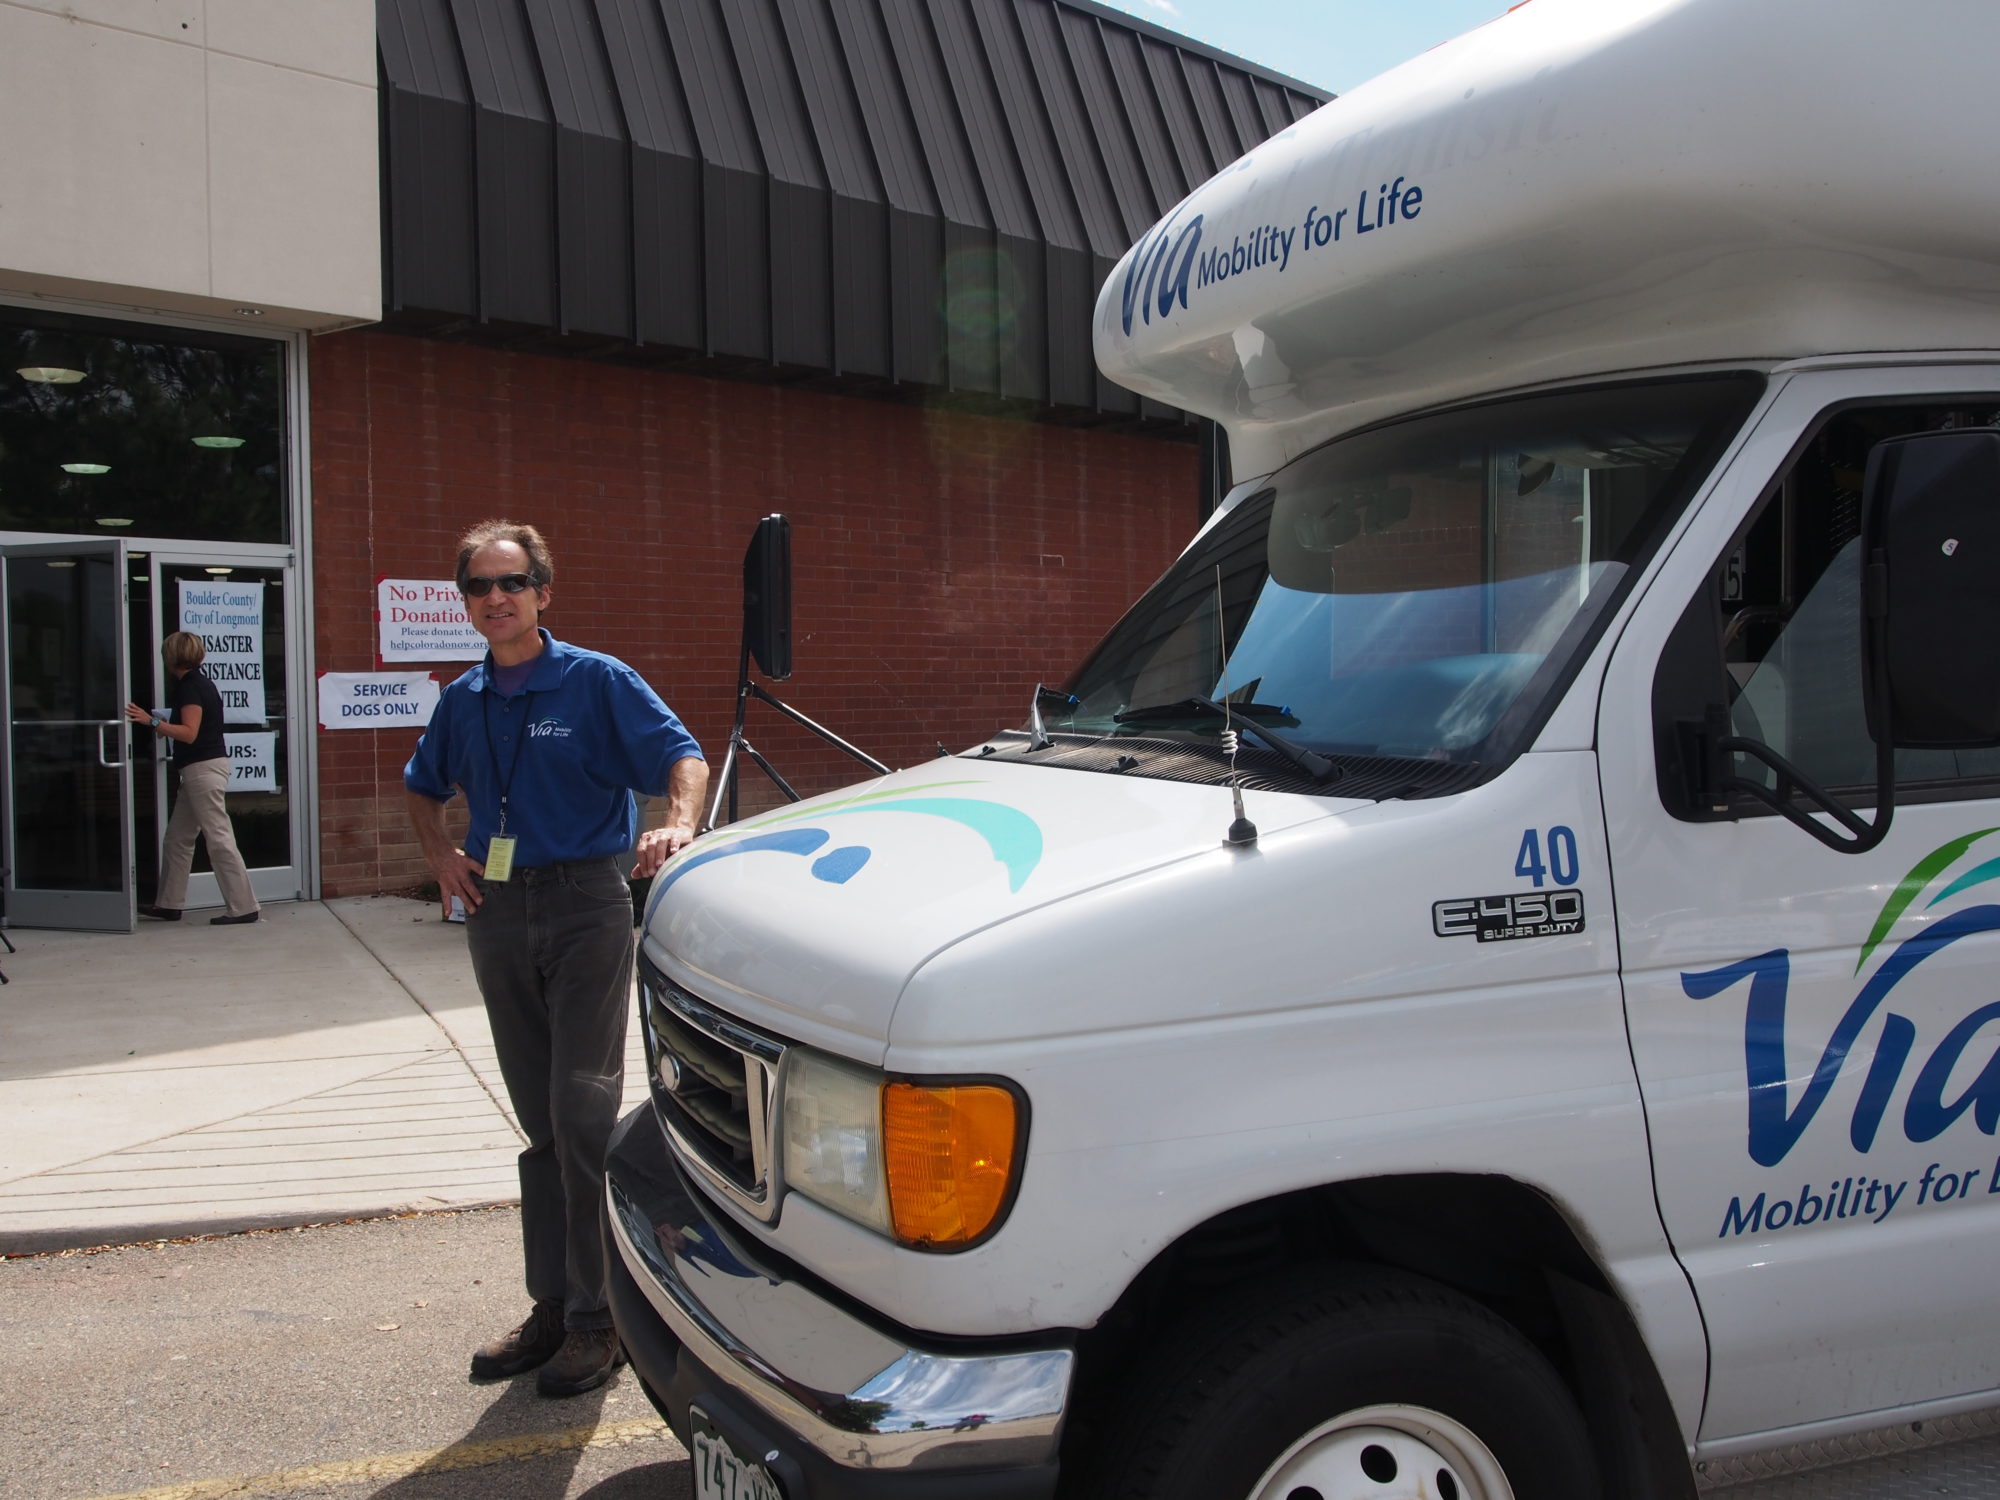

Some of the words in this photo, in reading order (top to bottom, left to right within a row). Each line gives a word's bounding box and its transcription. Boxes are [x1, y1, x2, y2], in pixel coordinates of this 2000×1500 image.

[1197, 225, 1296, 289] Mobility
[1303, 206, 1347, 251] for
[1357, 176, 1423, 234] Life
[1122, 205, 1206, 337] Via
[186, 591, 220, 606] Boulder
[388, 585, 418, 601] No
[184, 610, 203, 628] City
[204, 610, 214, 624] of
[216, 611, 259, 629] Longmont
[391, 607, 472, 623] Donatio
[401, 627, 429, 636] Please
[431, 627, 463, 636] donate
[198, 635, 253, 653] ISASTER
[200, 662, 261, 680] SISTANCE
[353, 683, 407, 697] SERVICE
[342, 703, 381, 717] DOGS
[384, 702, 419, 715] ONLY
[528, 720, 553, 737] Via
[226, 745, 257, 758] URS:
[235, 765, 267, 779] 7PM
[1515, 825, 1579, 888] 40
[1484, 926, 1534, 940] SUPER
[1539, 921, 1578, 935] DUTY
[1680, 904, 2000, 1168] Via
[1719, 1176, 1908, 1239] Mobility
[1917, 1163, 1980, 1206] for
